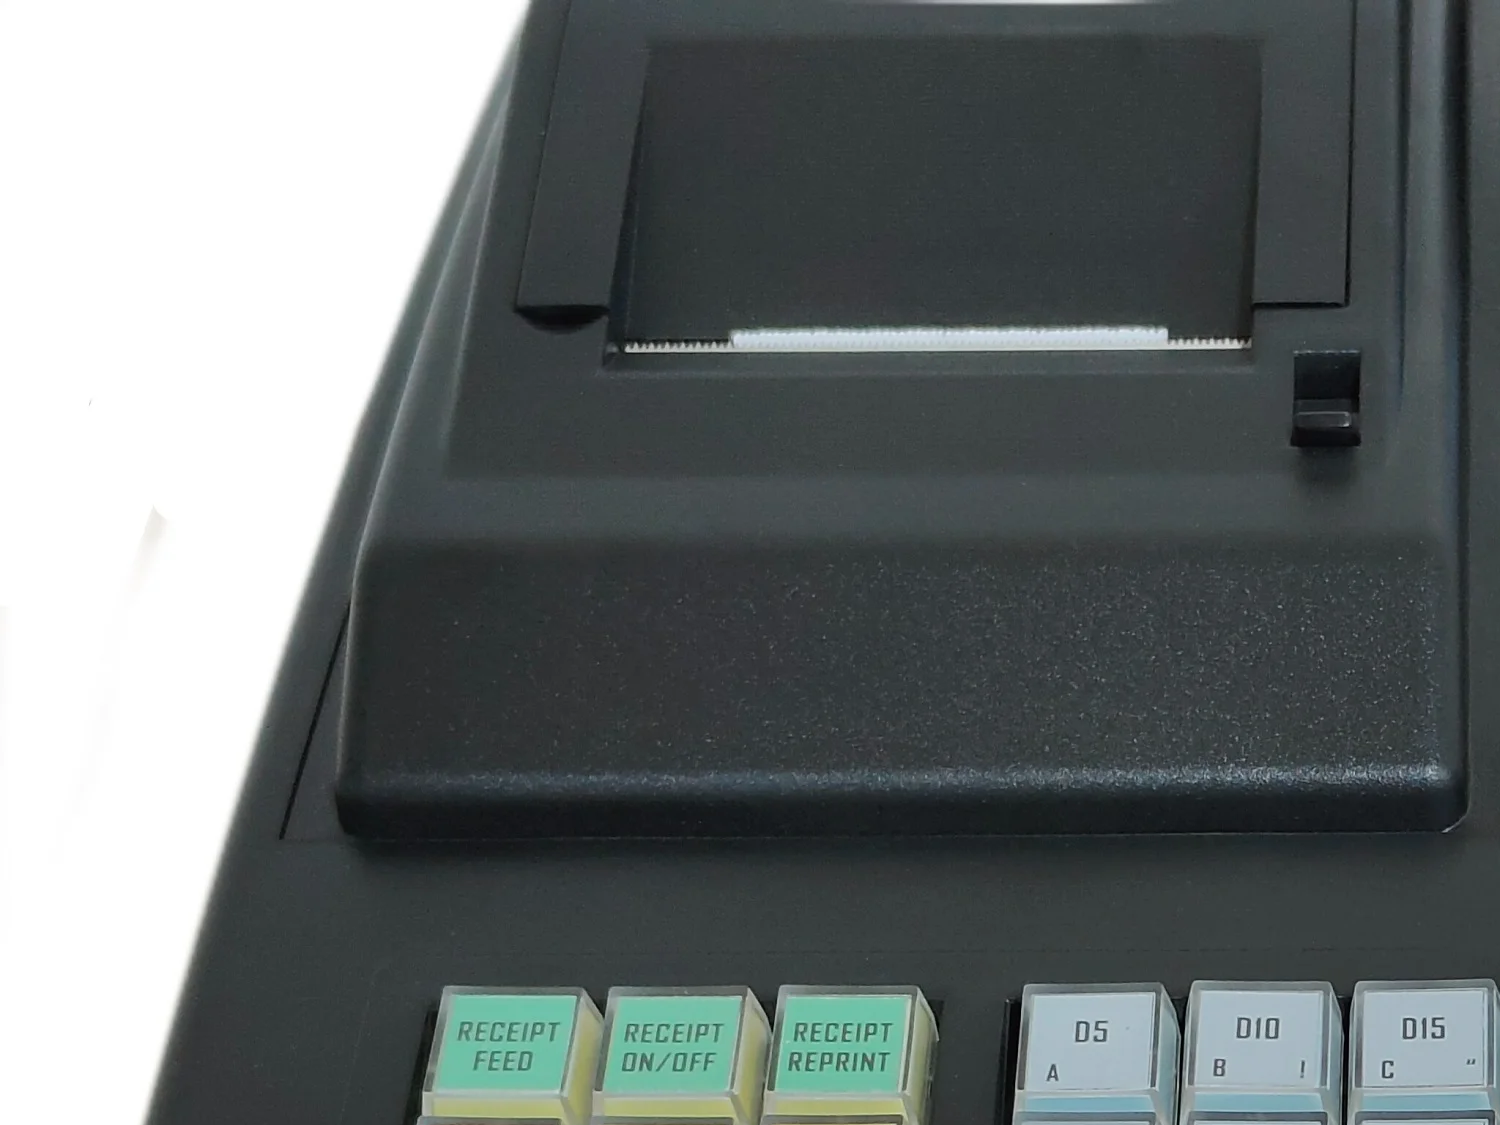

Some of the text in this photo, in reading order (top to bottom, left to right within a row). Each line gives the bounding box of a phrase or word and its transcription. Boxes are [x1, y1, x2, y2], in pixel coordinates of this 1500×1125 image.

[458, 1022, 560, 1042] RECEIPT
[624, 1024, 724, 1043] RECEIPT
[794, 1023, 892, 1042] RECEIPT
[1075, 1021, 1108, 1042] D5
[1237, 1018, 1279, 1039] D10
[1403, 1017, 1445, 1039] D15
[473, 1051, 533, 1071] FEED
[622, 1053, 716, 1072] ON/OFF
[788, 1052, 890, 1071] REPRINT
[1213, 1059, 1225, 1076] B
[1382, 1061, 1394, 1078] C
[1047, 1064, 1058, 1081] A
